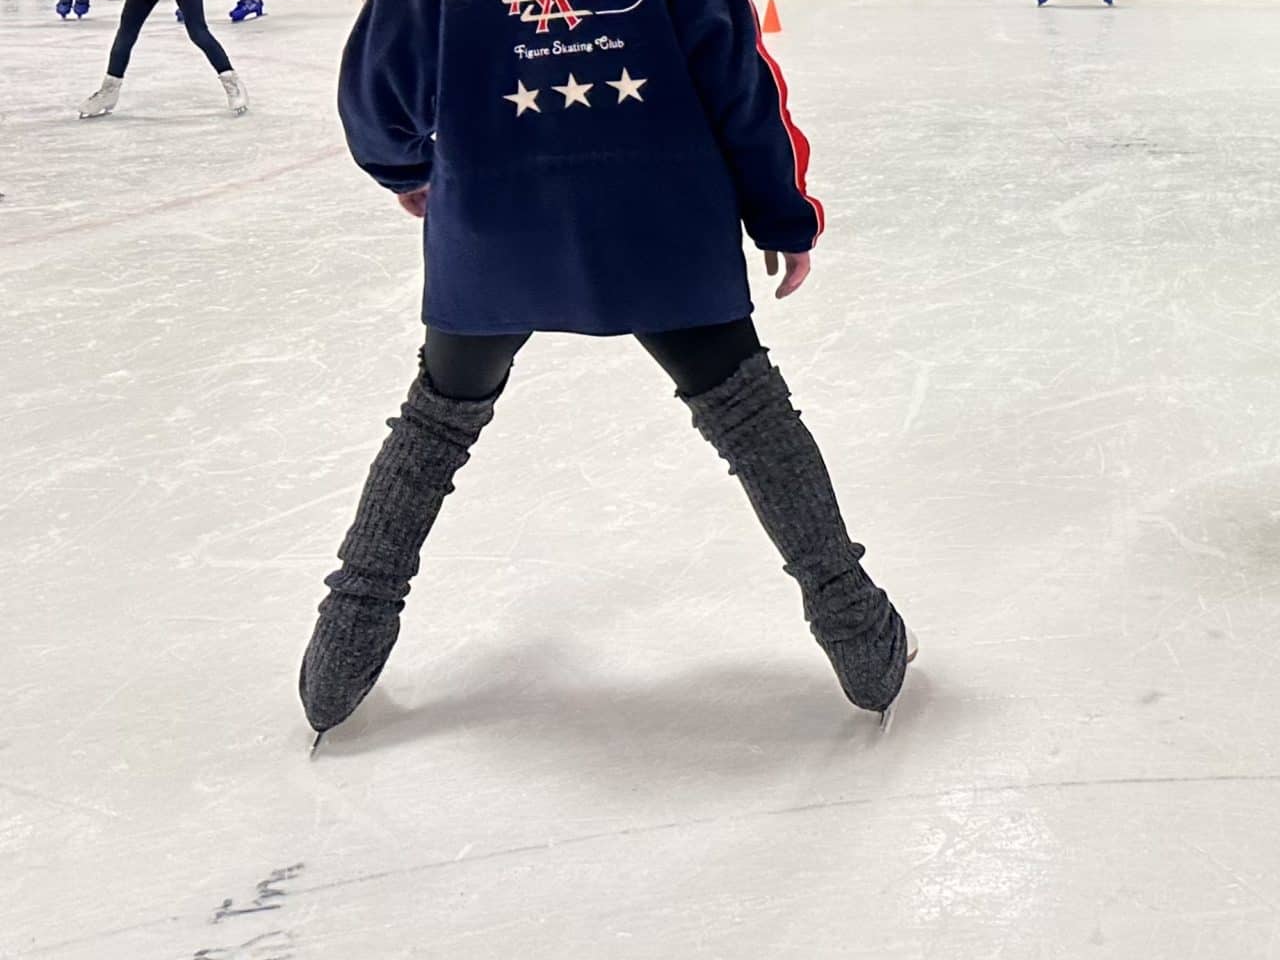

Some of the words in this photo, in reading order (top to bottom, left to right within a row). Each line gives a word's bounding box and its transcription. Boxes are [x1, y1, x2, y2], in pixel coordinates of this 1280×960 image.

[513, 44, 551, 60] Figure
[552, 40, 593, 55] Skating
[594, 35, 625, 50] Club
